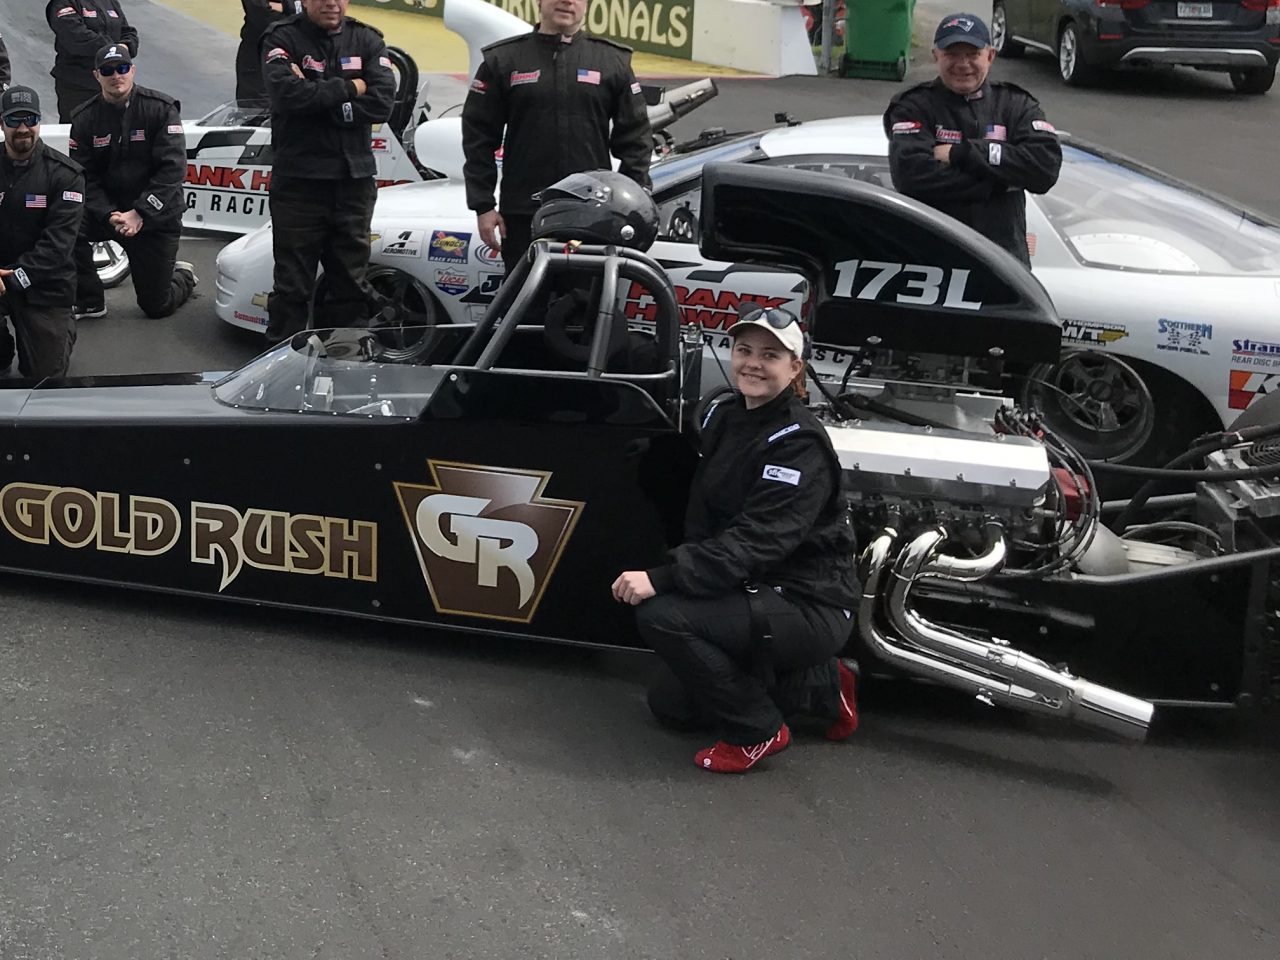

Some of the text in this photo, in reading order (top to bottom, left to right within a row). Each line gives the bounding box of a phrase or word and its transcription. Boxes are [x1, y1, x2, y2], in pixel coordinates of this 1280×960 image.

[185, 164, 249, 190] ANK
[382, 247, 418, 256] AEROMOTIVE
[432, 239, 466, 247] SUNOCO
[439, 275, 466, 284] LUCAS
[832, 259, 983, 311] 173L
[1158, 319, 1213, 340] SOUTHERN
[1232, 355, 1271, 367] REAR DISC
[190, 501, 378, 593] RUSH
[416, 493, 540, 610] GR
